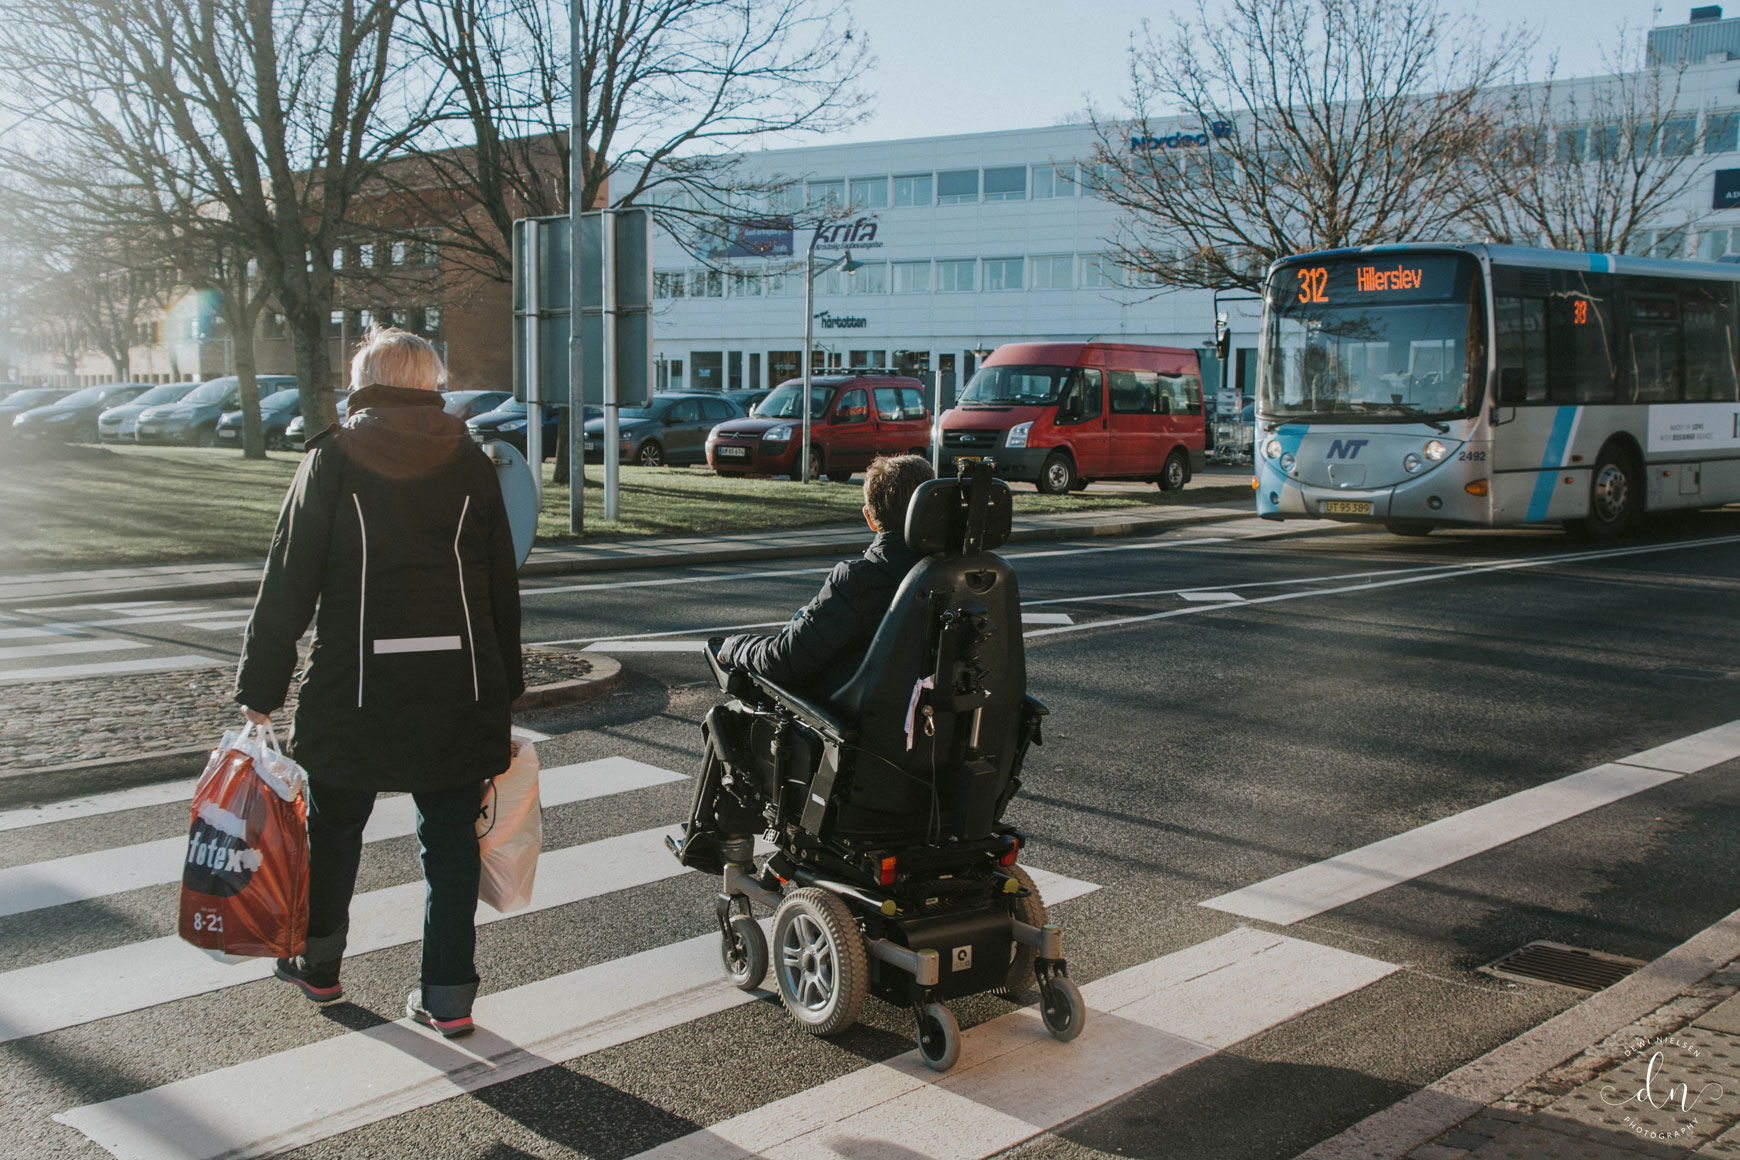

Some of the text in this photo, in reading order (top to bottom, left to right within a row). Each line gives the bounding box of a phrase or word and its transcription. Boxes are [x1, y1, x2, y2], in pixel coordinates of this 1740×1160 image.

[810, 217, 878, 249] krifa
[1297, 265, 1422, 303] 312 Hillerslev
[1326, 439, 1369, 459] NT
[1459, 452, 1486, 461] 2492
[1326, 503, 1370, 513] UT 95 389
